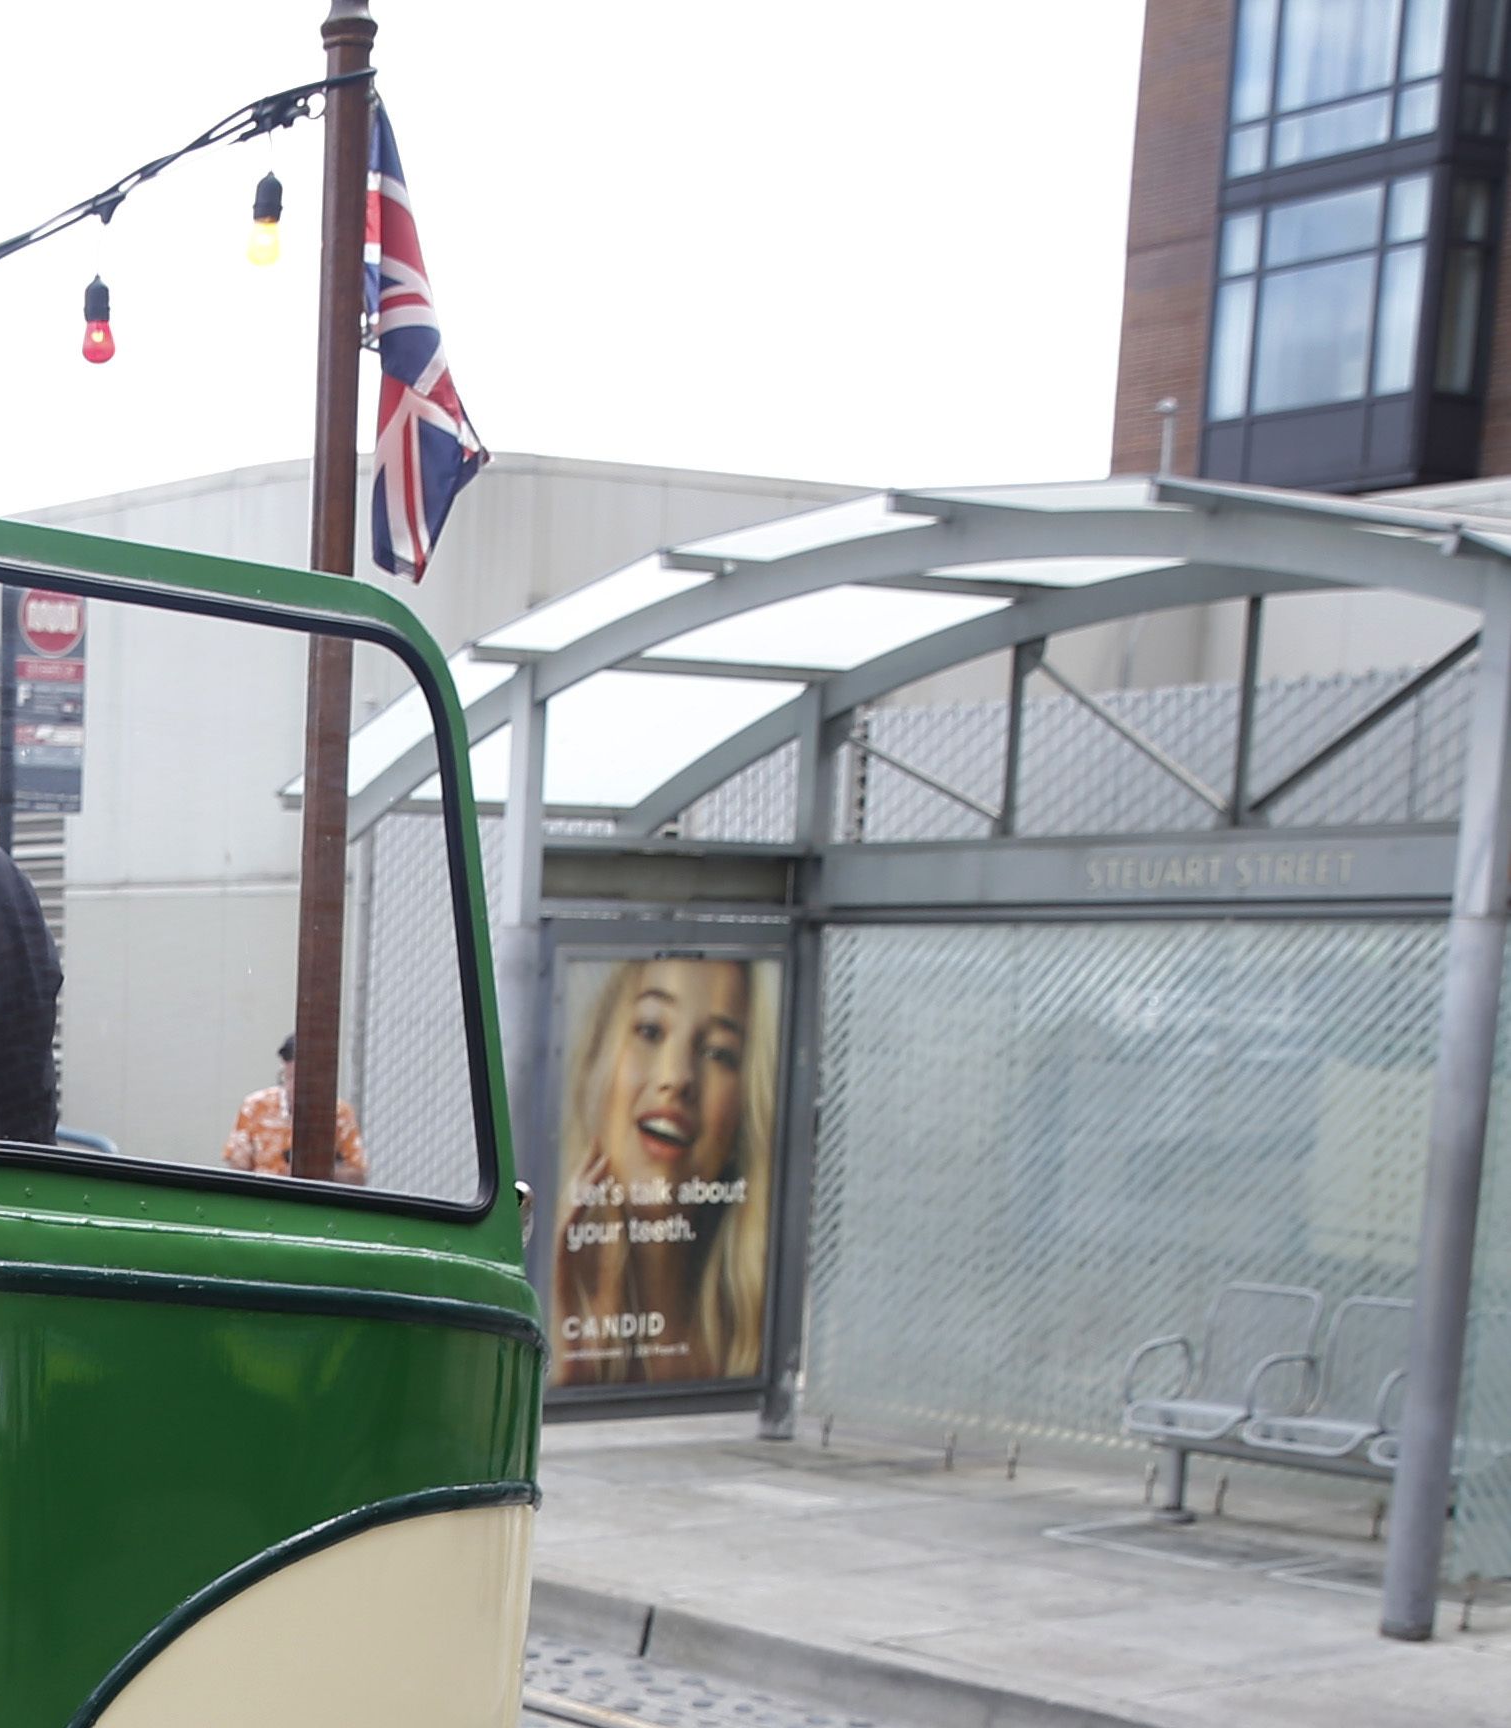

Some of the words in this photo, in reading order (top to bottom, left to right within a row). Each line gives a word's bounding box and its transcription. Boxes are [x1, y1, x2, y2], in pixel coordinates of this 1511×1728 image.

[1085, 854, 1226, 890] STEUART
[1234, 850, 1357, 889] STREET
[629, 1175, 673, 1205] talk
[678, 1175, 748, 1205] about
[567, 1221, 625, 1252] your
[628, 1213, 697, 1244] teeth.
[562, 1311, 666, 1341] CANDID
